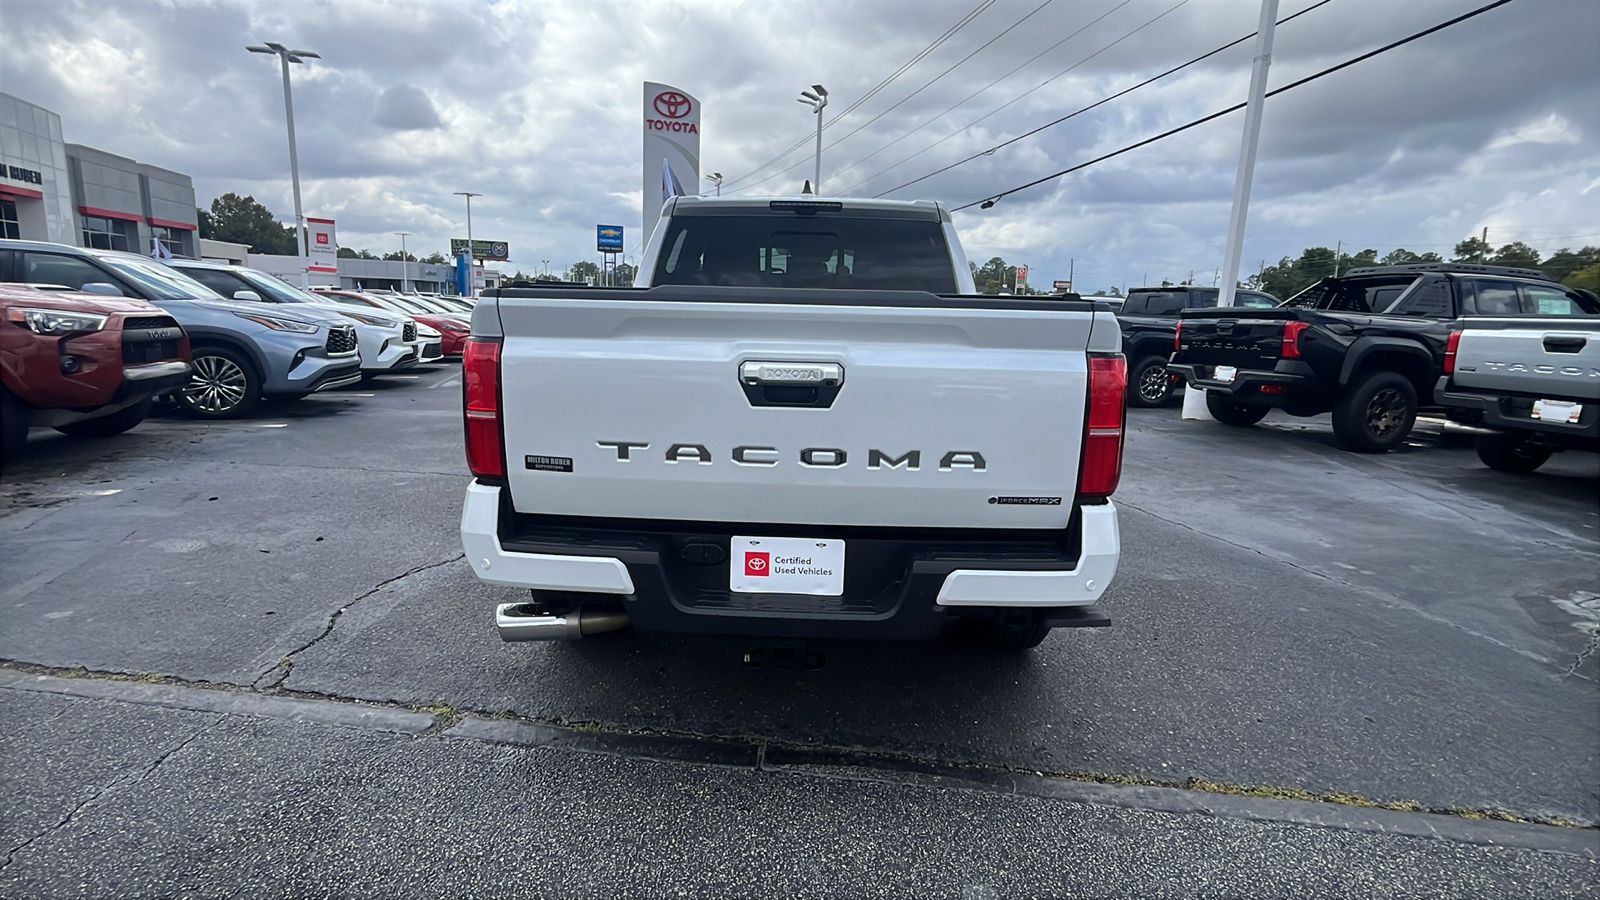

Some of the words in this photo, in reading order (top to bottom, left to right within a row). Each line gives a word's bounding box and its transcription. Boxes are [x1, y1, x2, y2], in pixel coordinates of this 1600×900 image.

[646, 119, 698, 134] TOYOTA
[766, 368, 818, 380] TOYOTA
[527, 456, 550, 464] MILTON
[550, 458, 571, 466] RUBEN
[595, 440, 988, 473] TACOMA
[774, 556, 812, 565] Certified
[797, 567, 833, 576] Vehicles
